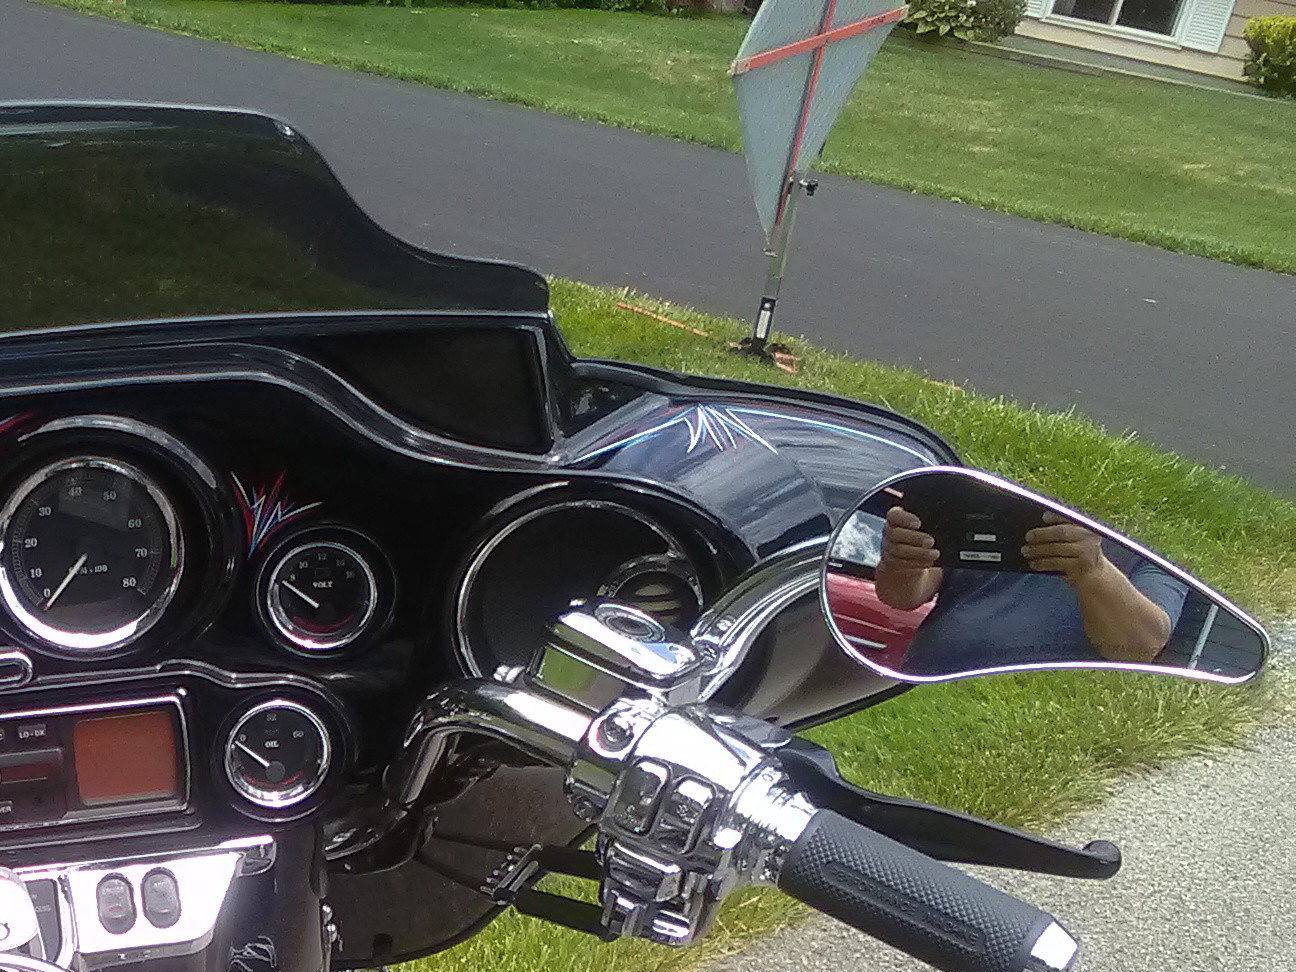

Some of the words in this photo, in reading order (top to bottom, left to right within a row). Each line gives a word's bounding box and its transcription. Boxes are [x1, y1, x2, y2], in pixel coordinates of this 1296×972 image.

[39, 506, 52, 517] 30
[128, 519, 142, 529] 60
[24, 537, 38, 548] 20
[135, 548, 148, 559] 70
[30, 568, 42, 578] 10
[122, 578, 136, 588] 80
[312, 581, 333, 589] VOLT
[43, 588, 51, 598] 0
[264, 740, 280, 749] OIL
